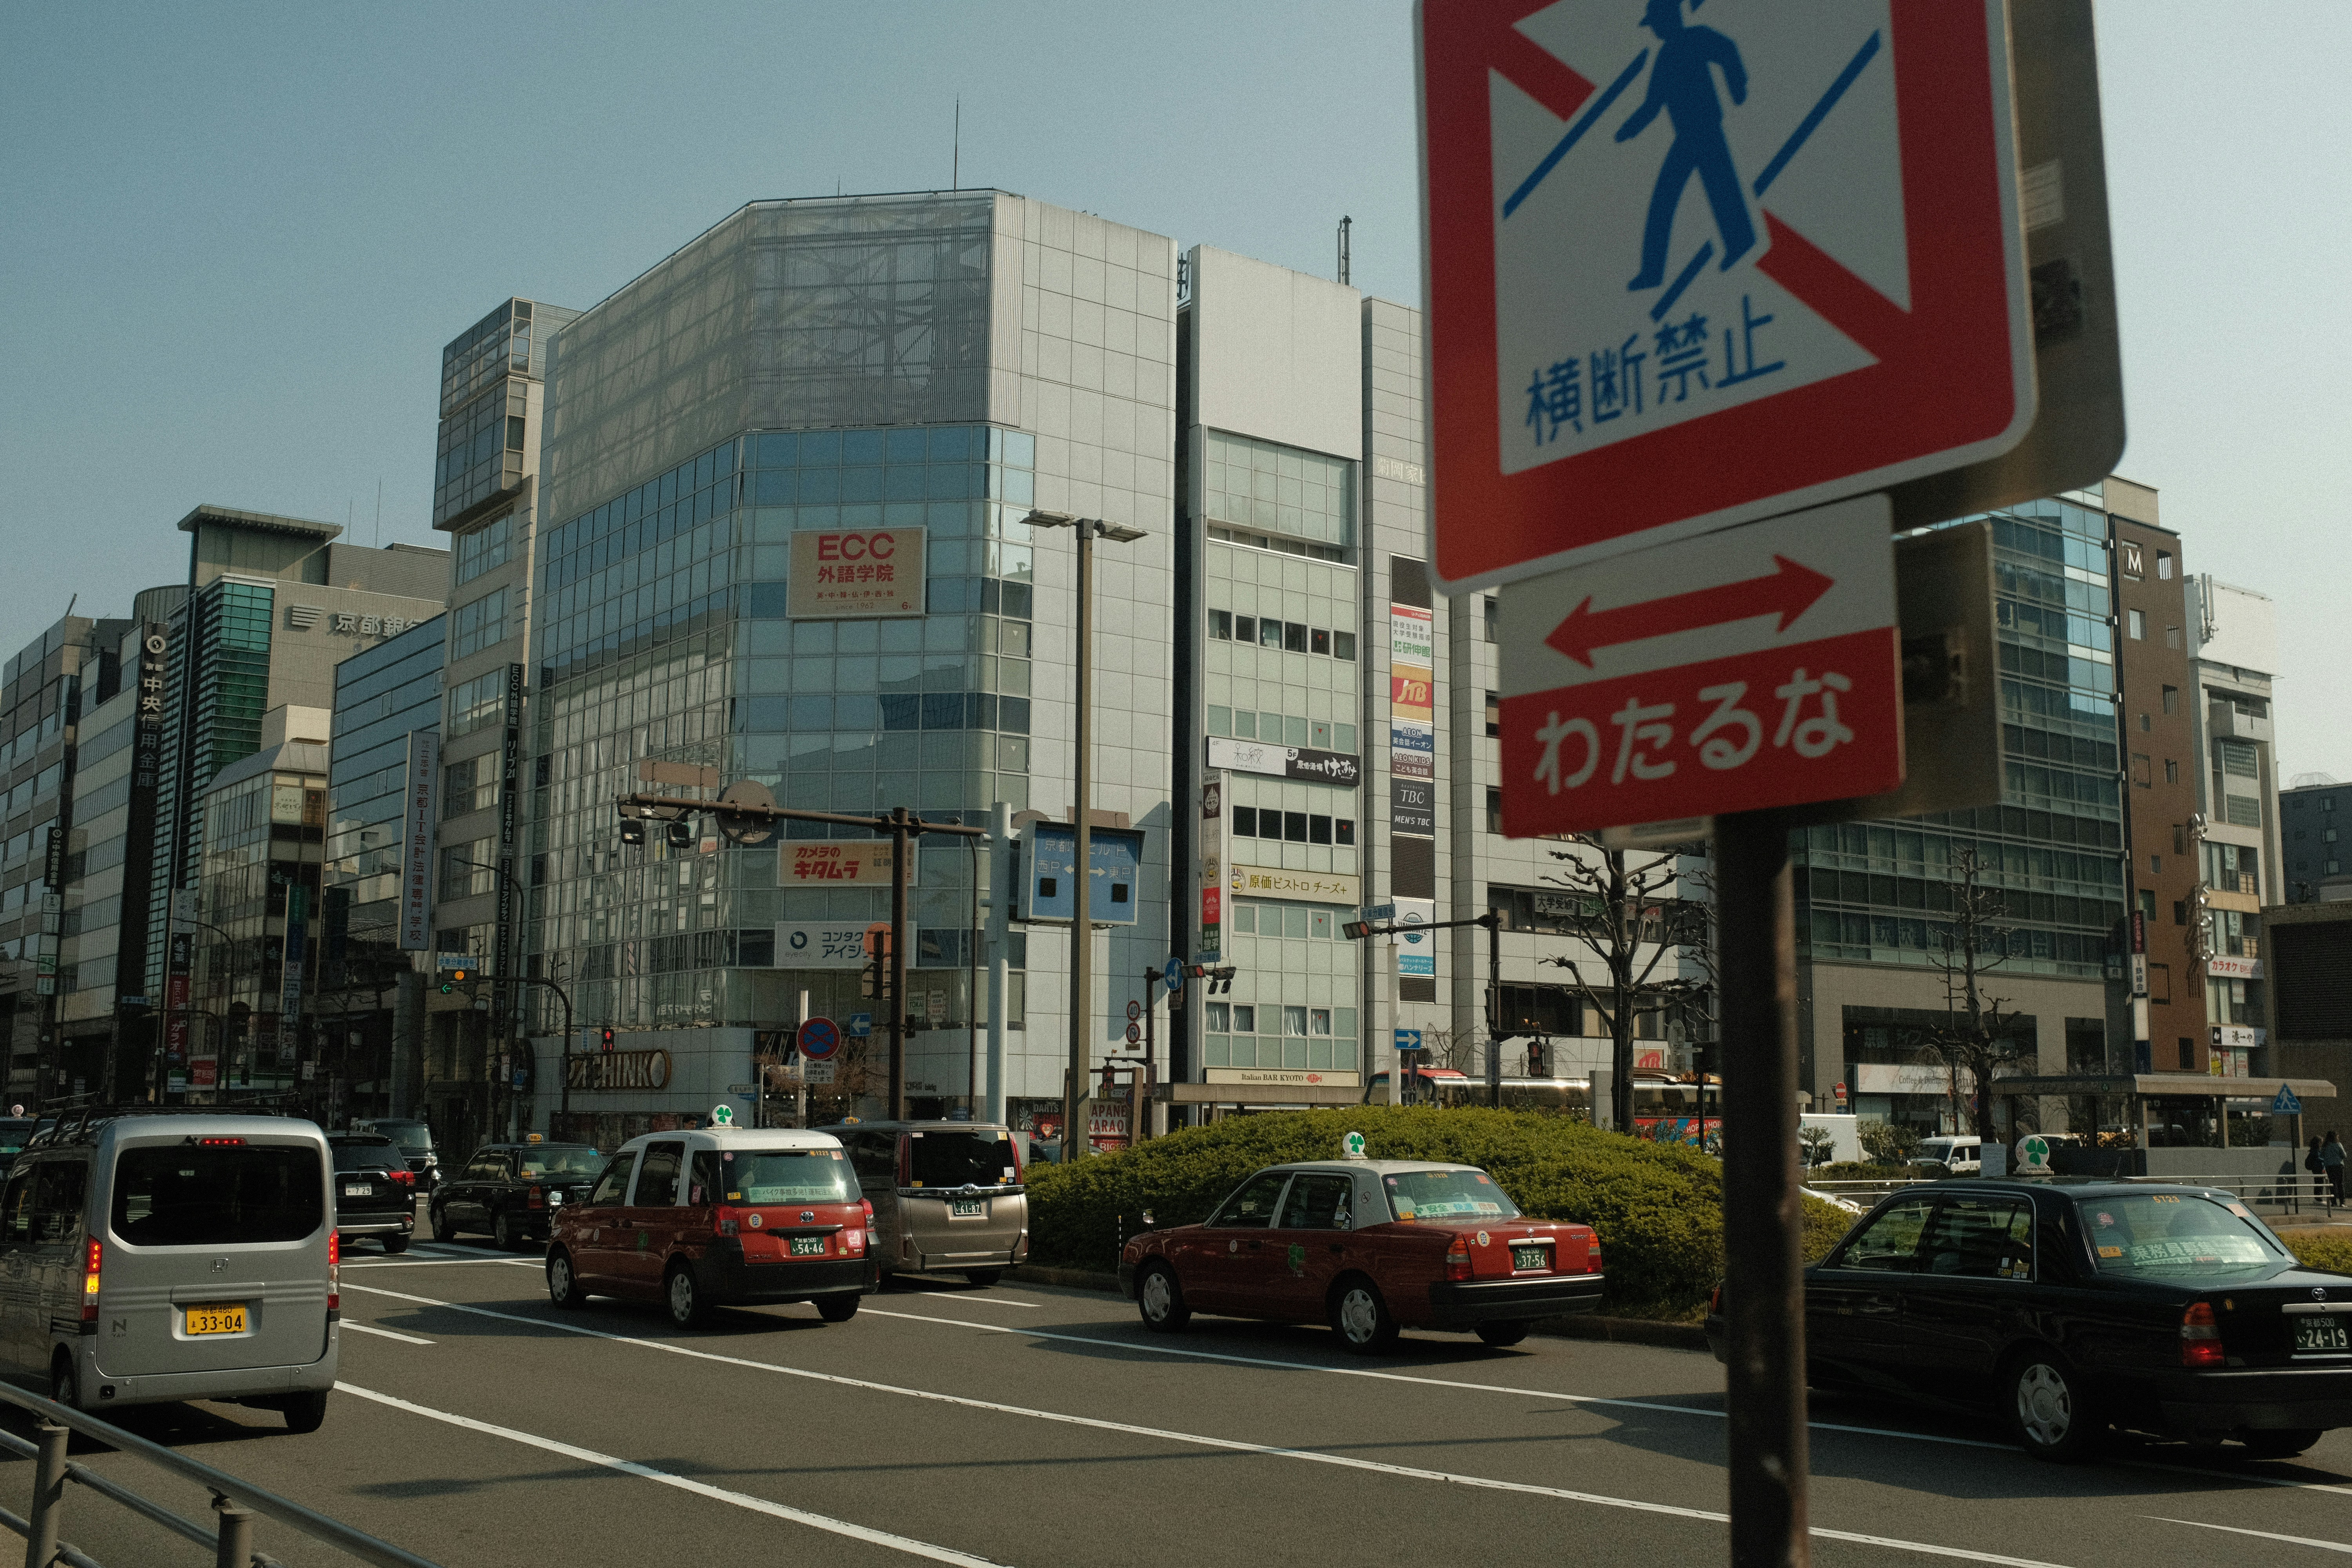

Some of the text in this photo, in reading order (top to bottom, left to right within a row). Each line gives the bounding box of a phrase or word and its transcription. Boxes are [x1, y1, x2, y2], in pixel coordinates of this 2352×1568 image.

[1524, 294, 1786, 446] 横断禁止
[818, 533, 895, 561] ECC
[2128, 549, 2143, 573] M
[817, 564, 894, 584] 外語学院
[1393, 621, 1424, 632] 現役生対象
[1393, 629, 1430, 641] 大学受験指導
[1403, 642, 1431, 658] 研伸館
[1397, 679, 1427, 703] JTB
[137, 676, 162, 786] 中央信用金庫
[1402, 727, 1422, 737] AEON
[1534, 666, 1854, 795] わたるな
[1393, 737, 1431, 749] 英会話イーオン
[1287, 749, 1297, 758] 5F
[1394, 753, 1430, 766] AEON KIDS
[1396, 764, 1428, 775] こども英会話
[1400, 789, 1425, 804] TBC
[1394, 815, 1431, 827] MEN'S TBC
[796, 847, 841, 858] カメラの
[794, 861, 860, 879] キタムラ
[1249, 875, 1309, 891] 原価ビストロ
[1537, 894, 1573, 910] 大学受験
[1361, 906, 1394, 919] 歩車分離信号
[785, 950, 811, 959] eyecity
[2212, 960, 2238, 972] カラオケ
[1130, 1005, 1138, 1016] 40
[1899, 1075, 1917, 1085] Coffee
[1034, 1103, 1059, 1113] DARTS
[1089, 1104, 1127, 1117] APANE
[1686, 1121, 1700, 1132] HOP
[1708, 1118, 1722, 1128] HOP
[960, 1205, 980, 1214] 61-87
[1426, 1204, 1450, 1213] 安全
[798, 1243, 824, 1254] 54-46
[2130, 1241, 2218, 1261] 乗務員募集
[1522, 1255, 1545, 1267] 37-56
[201, 1306, 232, 1314] 京都480
[113, 1319, 127, 1332] N
[200, 1315, 242, 1331] 33-04
[2306, 1318, 2335, 1327] 京都500
[2297, 1328, 2347, 1347] い 24-19
